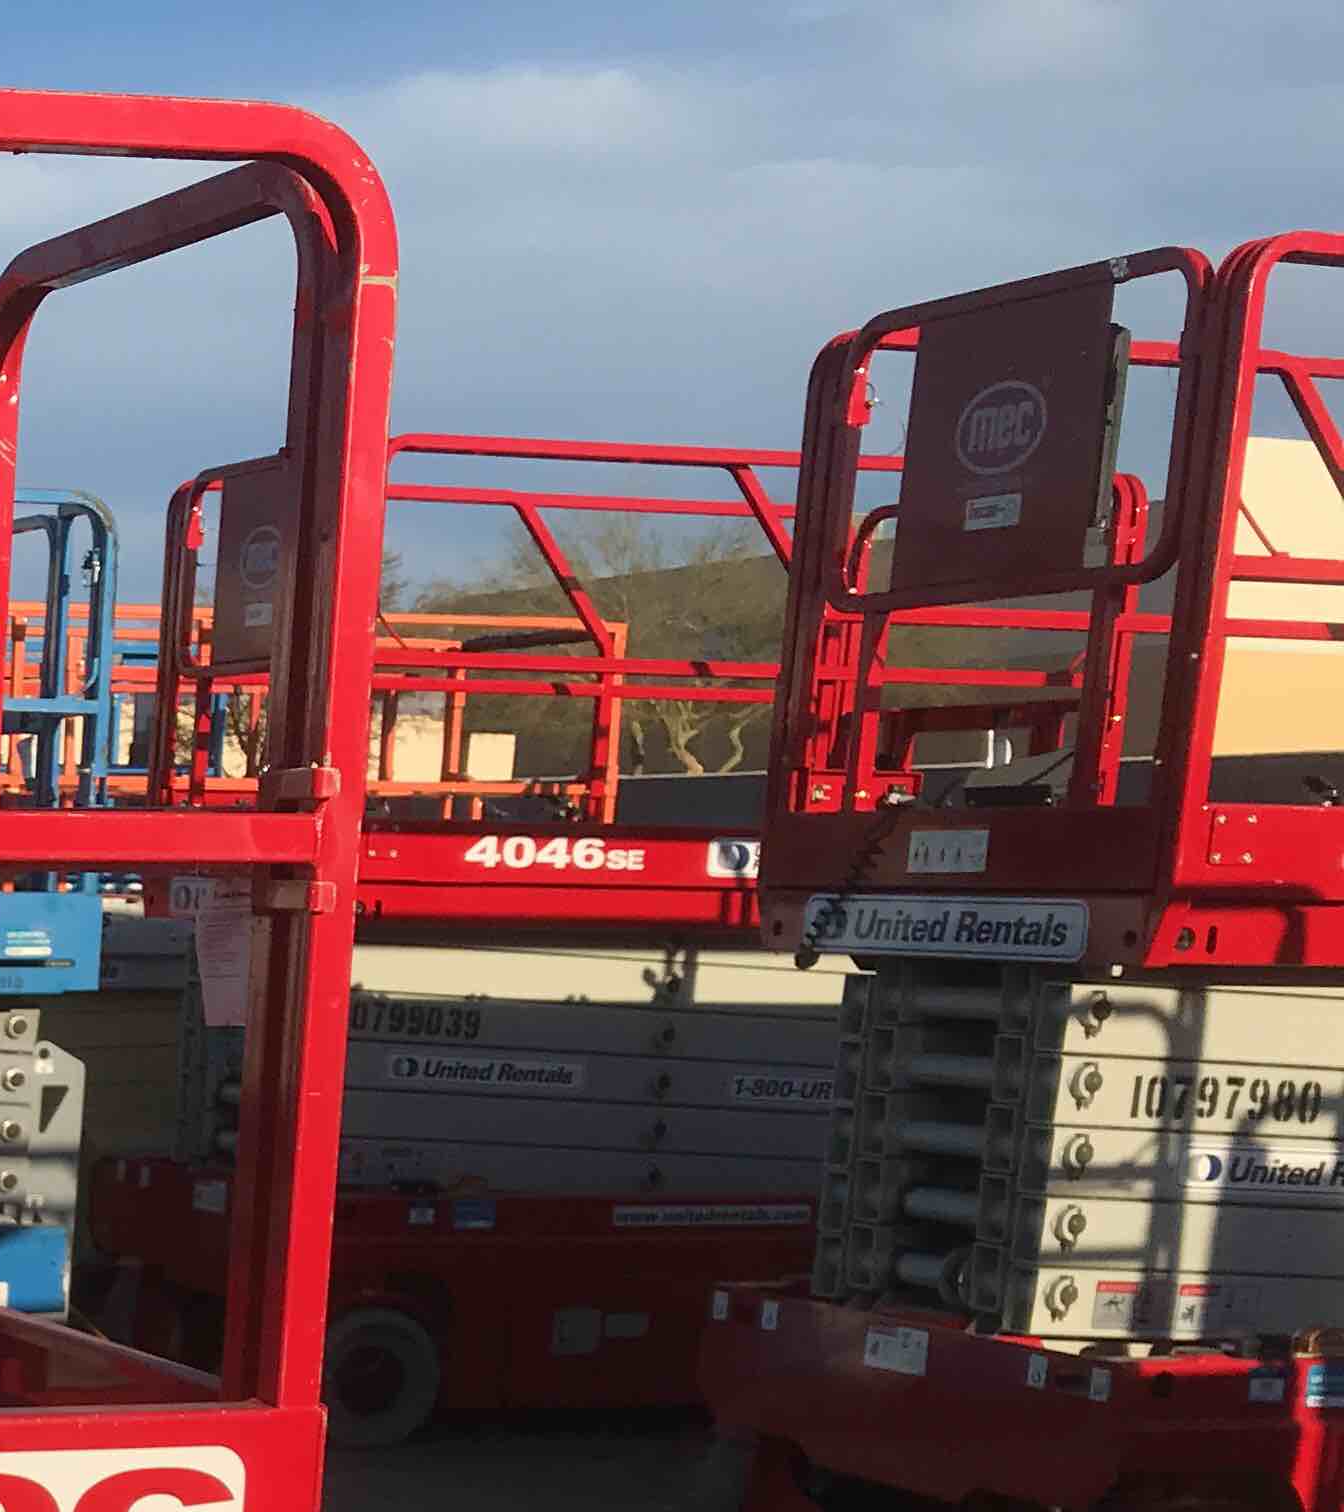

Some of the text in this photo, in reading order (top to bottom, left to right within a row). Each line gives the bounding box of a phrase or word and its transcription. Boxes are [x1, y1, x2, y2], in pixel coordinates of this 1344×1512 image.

[463, 835, 644, 872] 4046SE
[855, 908, 1069, 948] United Rentals
[350, 1001, 482, 1041] 0799039
[422, 1060, 574, 1085] United Rentals
[734, 1078, 833, 1100] 1-800-UR
[1129, 1074, 1322, 1124] 10797980
[1229, 1153, 1327, 1187] United
